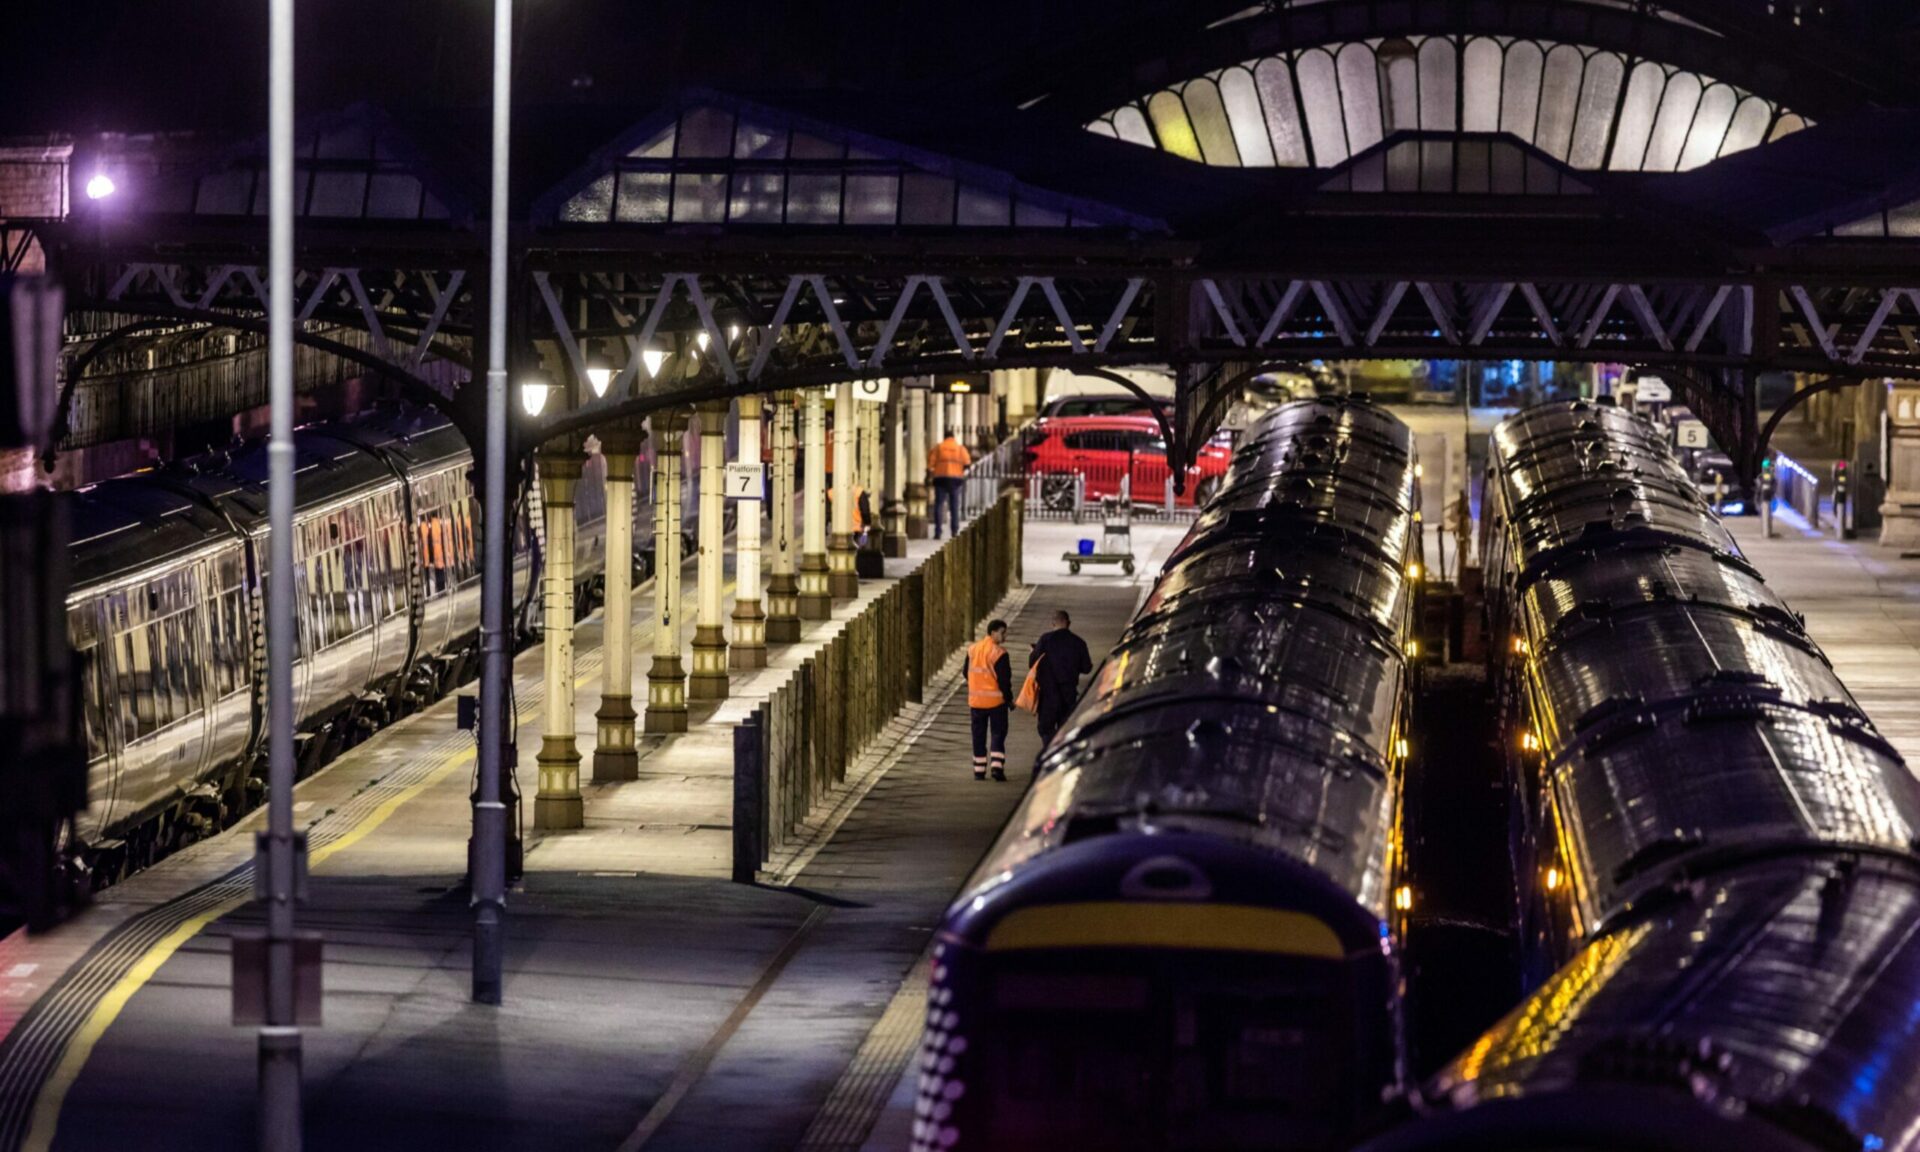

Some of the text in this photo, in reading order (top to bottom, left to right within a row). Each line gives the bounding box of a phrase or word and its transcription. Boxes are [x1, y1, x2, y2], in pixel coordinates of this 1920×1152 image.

[1687, 429, 1697, 443] 5
[729, 465, 761, 473] Platform
[739, 476, 750, 492] 7
